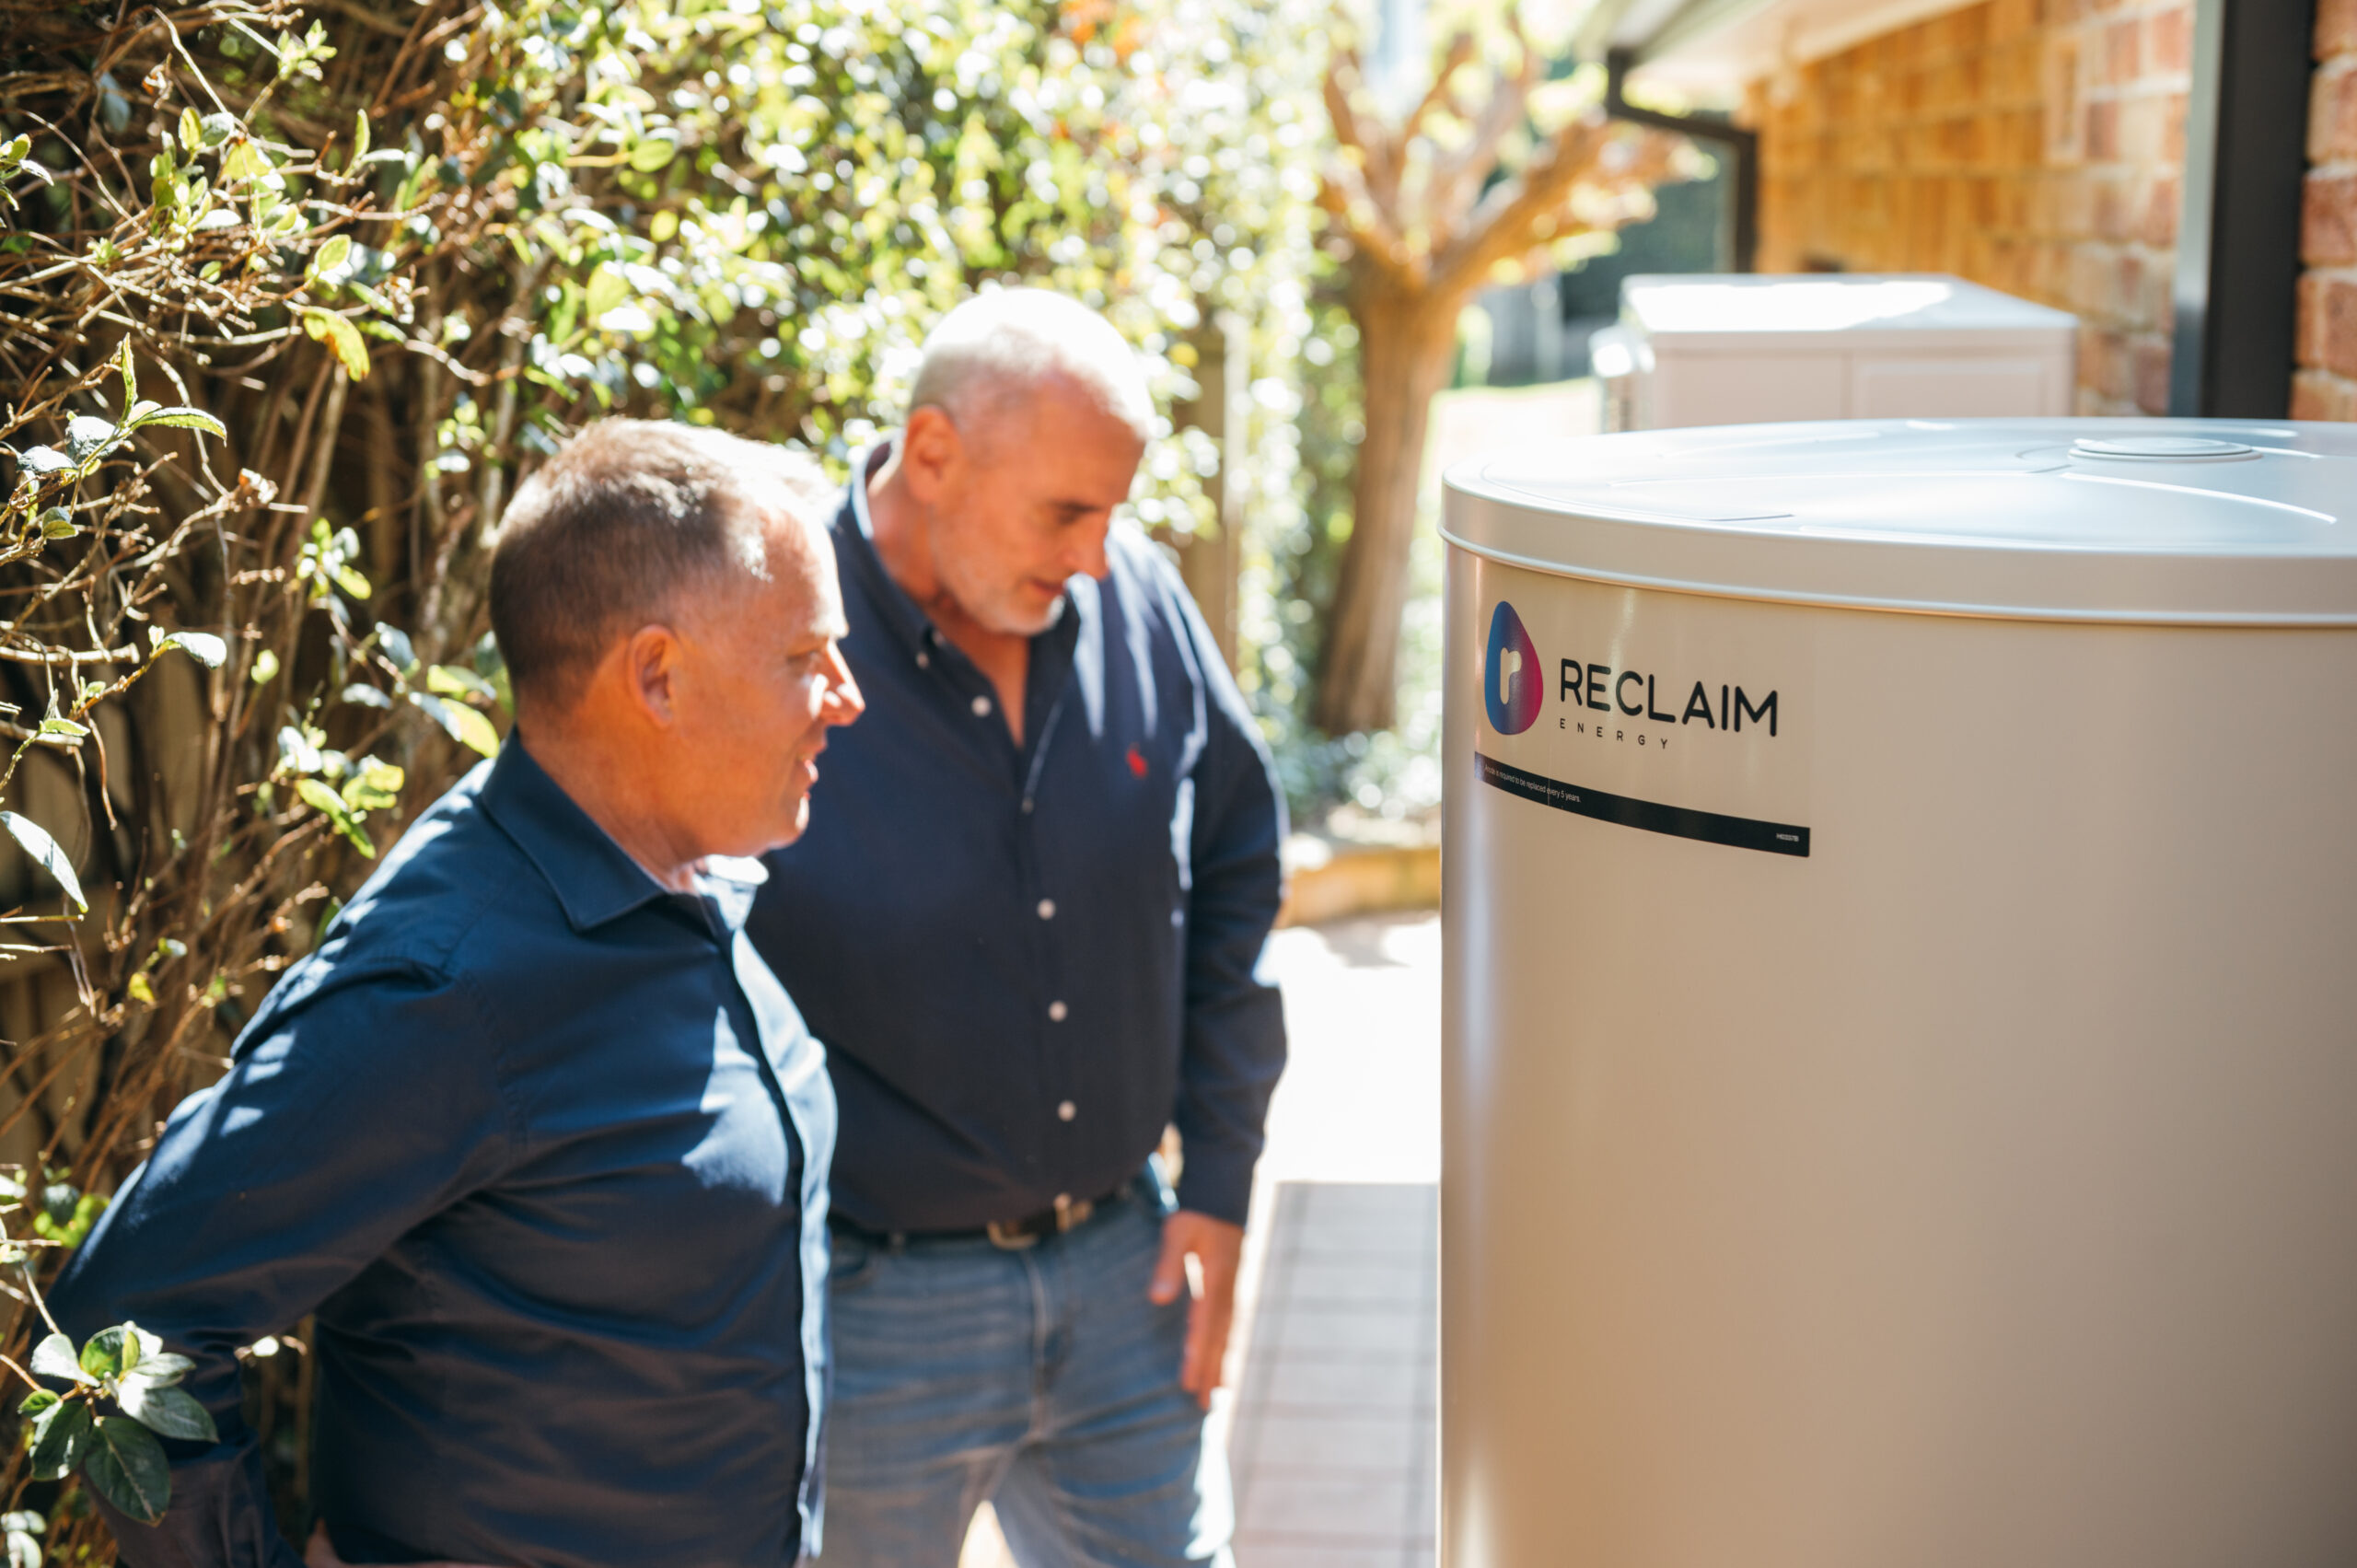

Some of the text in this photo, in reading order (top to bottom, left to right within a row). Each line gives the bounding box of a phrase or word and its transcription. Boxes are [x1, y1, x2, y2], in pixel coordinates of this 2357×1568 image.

[1561, 657, 1778, 738] RECLAIM
[1560, 717, 1668, 749] ENERGY
[1519, 777, 1526, 787] be
[1527, 781, 1546, 793] replaced
[1547, 788, 1560, 798] every
